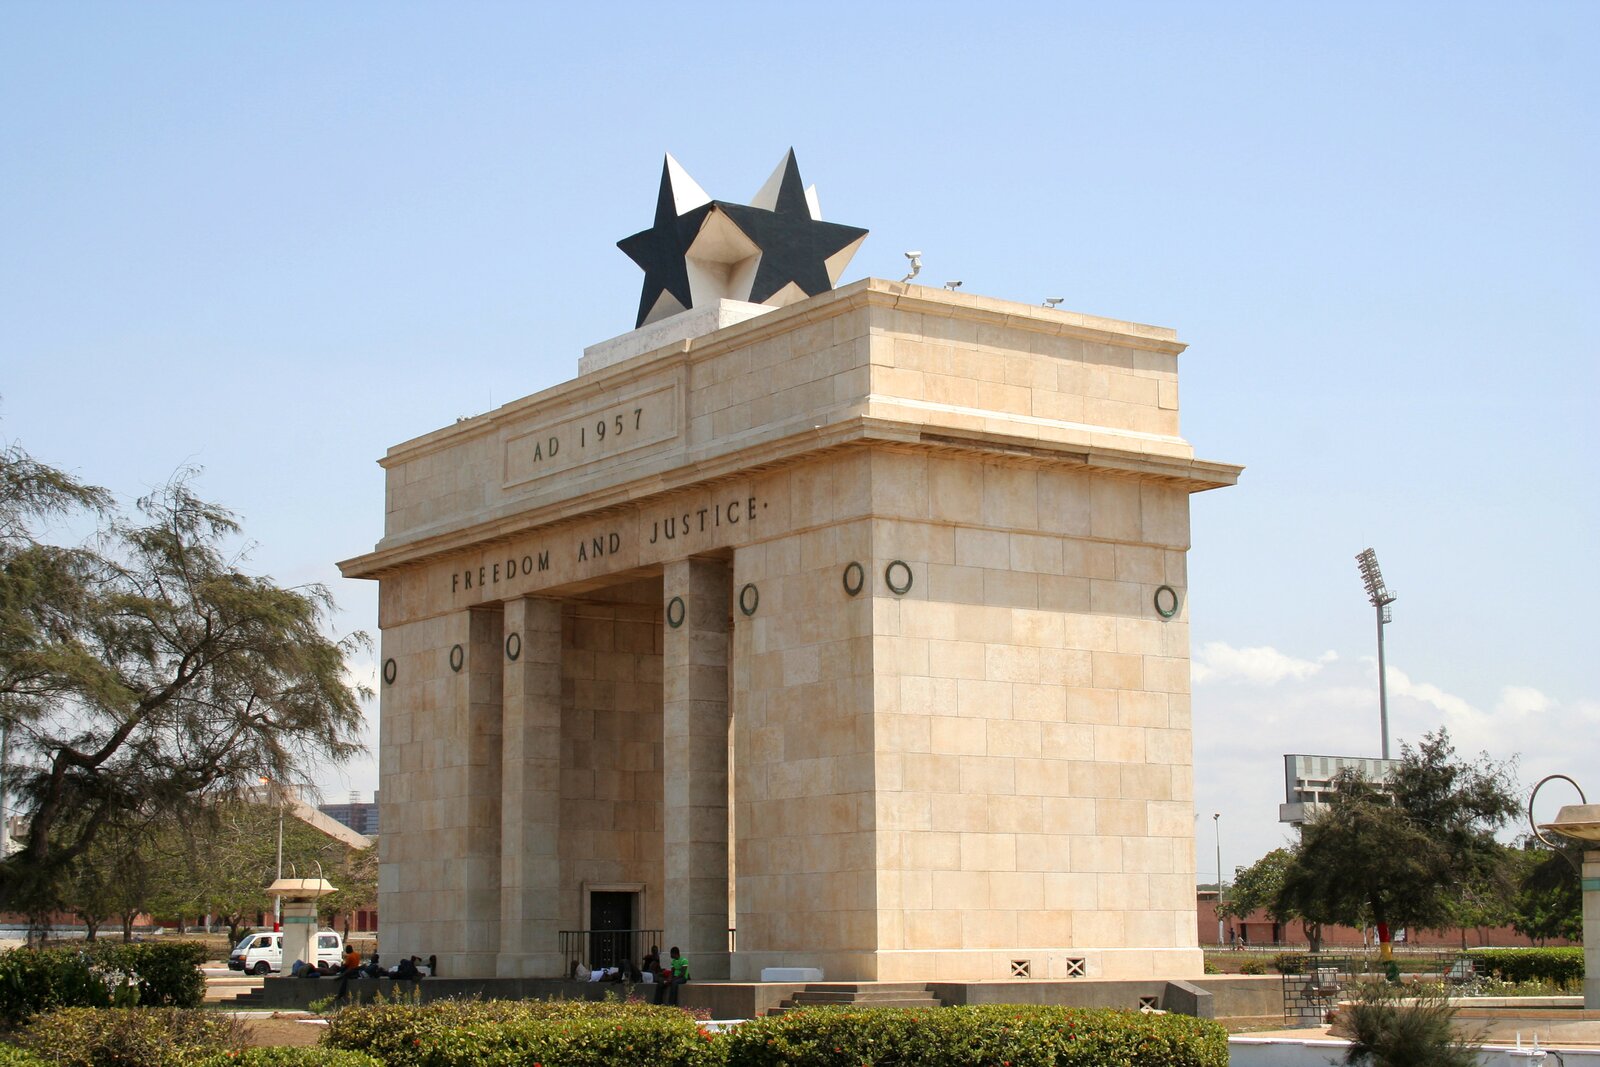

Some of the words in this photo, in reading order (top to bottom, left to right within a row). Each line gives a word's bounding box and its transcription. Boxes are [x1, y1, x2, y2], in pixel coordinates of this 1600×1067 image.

[533, 437, 560, 463] AD
[580, 408, 643, 448] 1957
[452, 550, 550, 593] FREEDOM
[578, 532, 621, 563] AND
